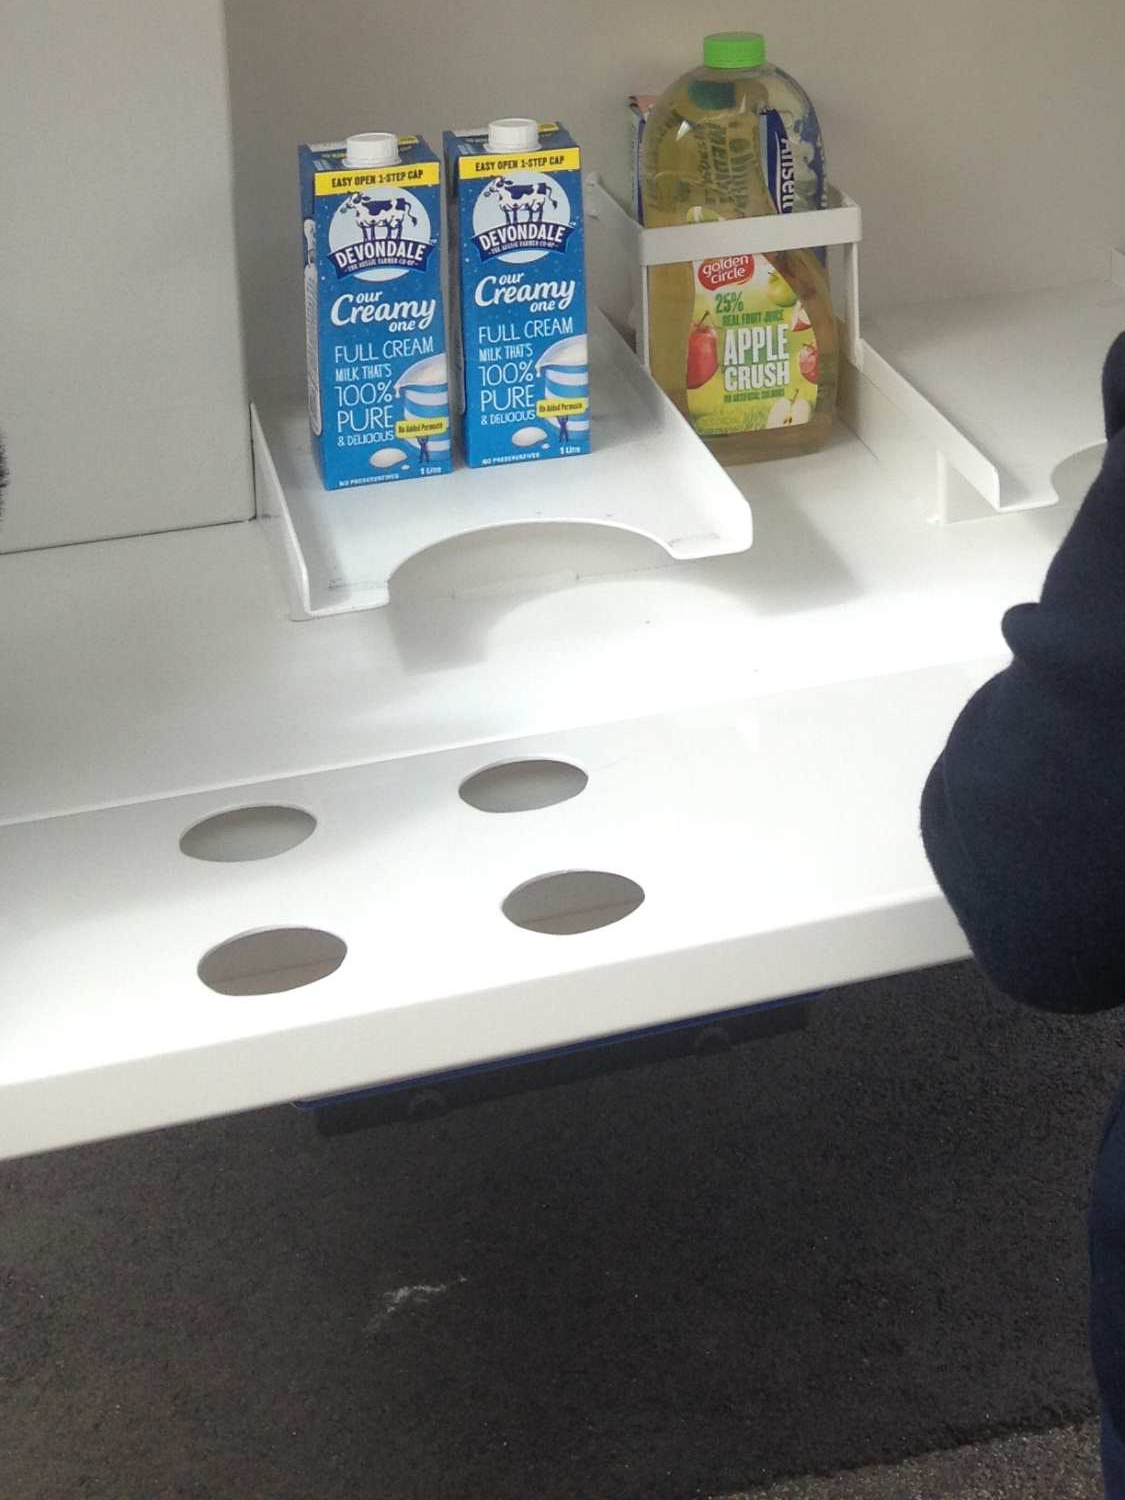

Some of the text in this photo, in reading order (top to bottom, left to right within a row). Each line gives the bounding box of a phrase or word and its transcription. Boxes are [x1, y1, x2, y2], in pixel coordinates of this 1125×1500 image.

[475, 155, 565, 172] EASY OPEN 1-STEP CAP
[331, 169, 424, 188] EASY OPEN 1-STEP CAP
[479, 223, 566, 251] DEVONDALE
[335, 241, 426, 268] DEVONDALE
[702, 254, 749, 277] golden
[499, 272, 524, 284] our
[711, 266, 746, 285] circle
[356, 291, 383, 303] our
[474, 275, 576, 311] Creamy
[715, 291, 744, 314] 25%
[330, 294, 437, 330] Creamy
[530, 300, 556, 313] one
[388, 320, 416, 333] one
[479, 316, 573, 345] FULL CREAM
[335, 336, 434, 363] FULL CREAM
[479, 343, 533, 362] MILK THAT'S
[723, 323, 790, 367] APPLE
[335, 363, 392, 382] MILK THAT'S
[479, 360, 534, 387] 100%
[724, 361, 790, 392] CRUSH
[334, 379, 393, 407] 100%
[480, 384, 535, 412] PURE
[337, 405, 394, 433] PURE
[480, 409, 536, 426] & DELICIOUS
[337, 430, 395, 447] & DELICIOUS
